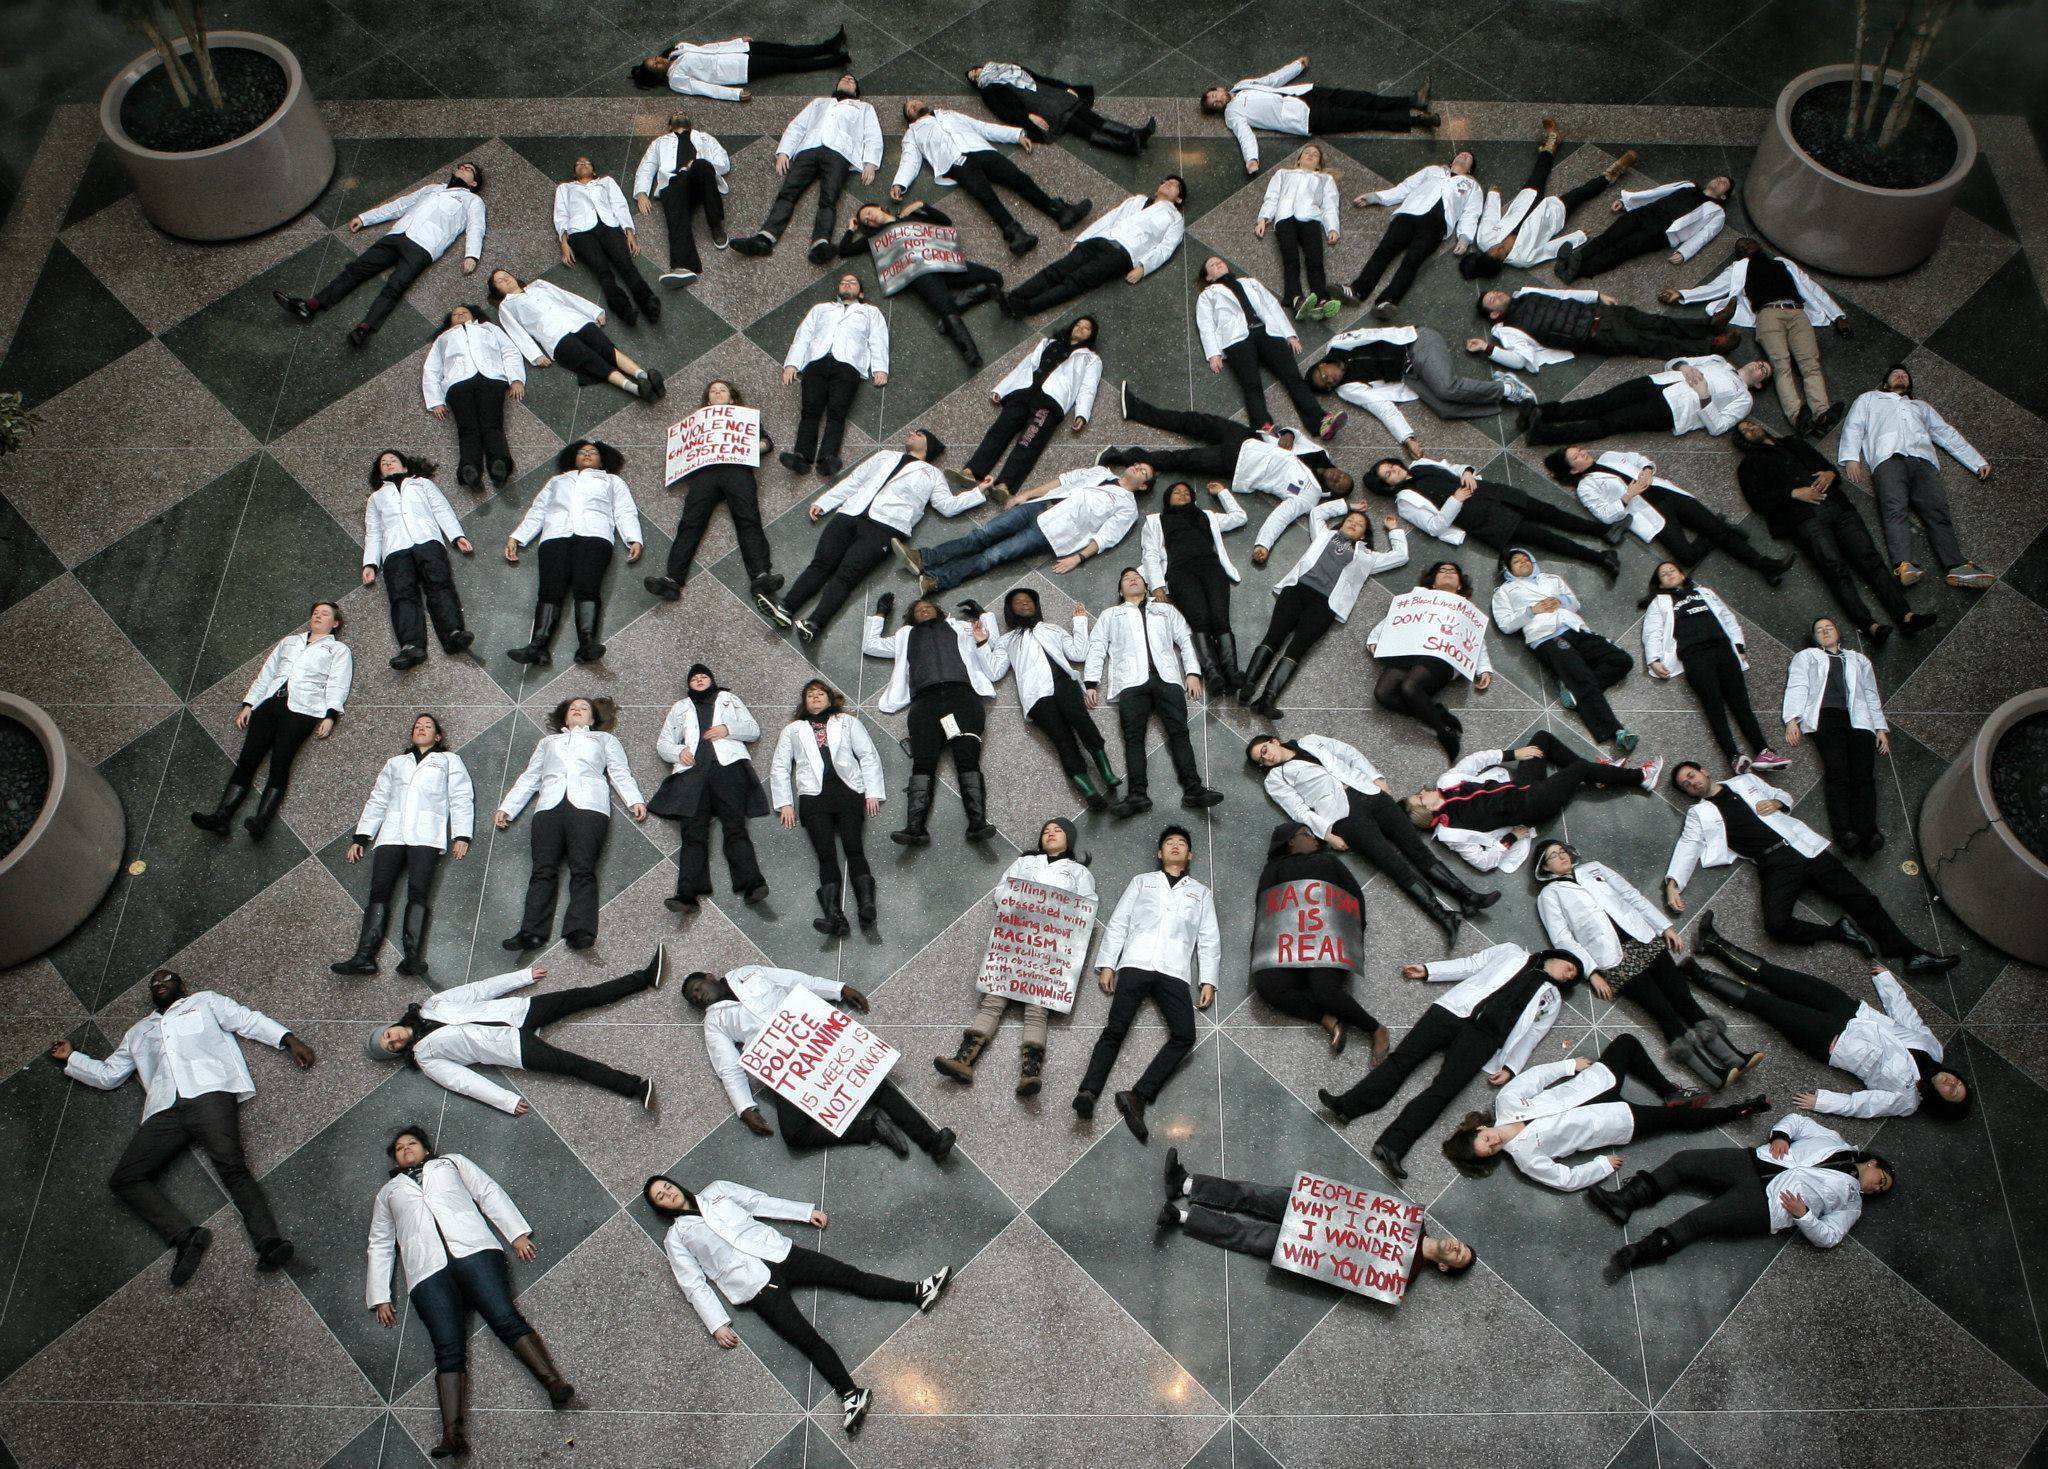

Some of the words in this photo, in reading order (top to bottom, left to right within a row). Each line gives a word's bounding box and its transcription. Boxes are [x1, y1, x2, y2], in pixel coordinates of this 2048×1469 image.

[873, 226, 911, 252] PUBLIC
[912, 224, 958, 241] SAFETY
[903, 239, 927, 249] NOT
[881, 252, 917, 281] PUBLIC
[669, 416, 695, 437] END
[702, 407, 735, 419] THE
[681, 419, 757, 443] VIOLENCE
[668, 432, 715, 460] CHANGE
[722, 432, 751, 446] THE
[686, 443, 751, 462] SYSTEM!
[1392, 611, 1438, 626] DON'T
[1422, 636, 1475, 670] SHOOT!
[1008, 879, 1047, 904] Telling
[1051, 890, 1071, 904] me
[1074, 898, 1093, 913] I'm
[1265, 882, 1361, 918] RACISM
[997, 912, 1040, 934] talking
[1043, 923, 1073, 938] about
[1064, 914, 1087, 928] with
[1298, 908, 1325, 932] IS
[993, 926, 1057, 952] RACISM
[1064, 945, 1072, 955] is
[1278, 933, 1357, 967] REAL
[985, 963, 1012, 974] with
[987, 952, 1008, 963] I'm
[991, 942, 1011, 952] like
[1015, 945, 1051, 965] telling
[1056, 957, 1072, 969] me
[979, 972, 1007, 982] when
[1009, 979, 1073, 1004] DROWNING
[741, 1010, 796, 1071] BETTER
[759, 1012, 820, 1084] POLICE
[775, 1010, 853, 1091] TRAINING
[799, 1092, 819, 1111] 15
[815, 1045, 855, 1091] WEEKS
[852, 1027, 869, 1044] IS
[818, 1083, 853, 1127] NOT
[846, 1038, 891, 1088] ENOUGH
[1291, 1196, 1339, 1221] WHY
[1344, 1210, 1359, 1229] I
[1297, 1176, 1367, 1210] PEOPLE
[1370, 1197, 1401, 1219] ASK
[1403, 1205, 1425, 1224] ME
[1299, 1220, 1317, 1241] I
[1325, 1226, 1404, 1266] WONDER
[1283, 1242, 1326, 1270] WHY
[1330, 1254, 1363, 1287] YOU
